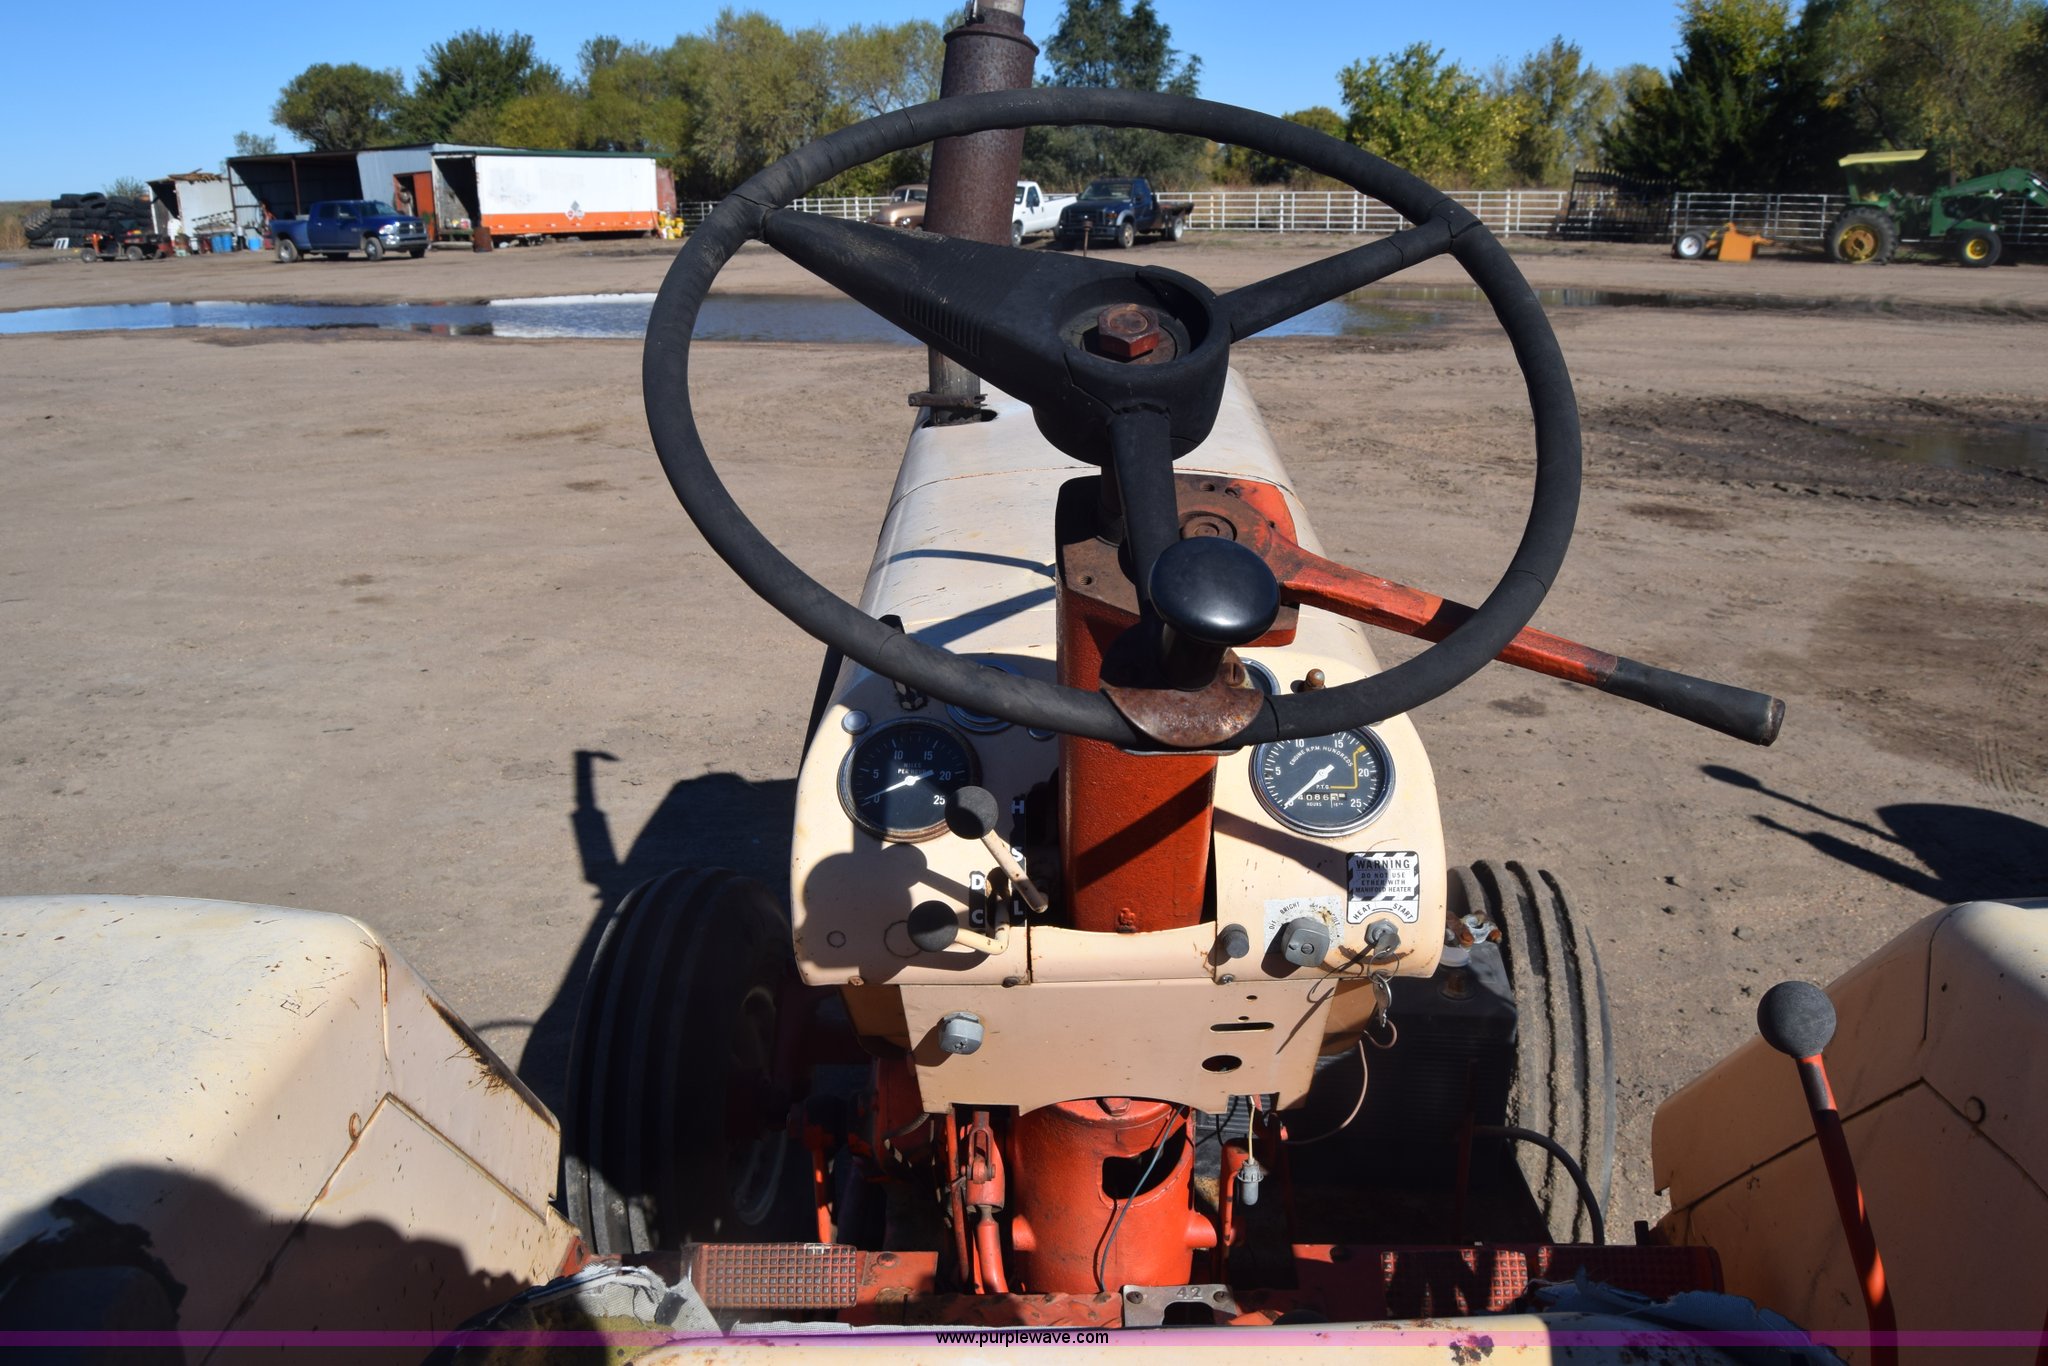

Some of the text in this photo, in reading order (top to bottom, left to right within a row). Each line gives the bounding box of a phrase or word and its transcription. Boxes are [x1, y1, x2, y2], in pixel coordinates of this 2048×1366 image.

[1295, 739, 1305, 748] 10
[1334, 739, 1344, 748] 15
[894, 751, 904, 760] 10
[924, 751, 933, 760] 15
[1289, 750, 1306, 766] ENGINE
[1322, 746, 1354, 767] HUNDREDS
[873, 769, 879, 779] 5
[940, 771, 951, 781] 20
[1275, 767, 1281, 776] 5
[1358, 768, 1370, 777] 20
[933, 794, 946, 805] 25
[1350, 798, 1362, 808] 25
[1011, 800, 1025, 814] H
[1011, 846, 1024, 862] S
[1356, 859, 1410, 869] WARNING
[971, 874, 985, 890] D
[1013, 900, 1024, 915] L
[1352, 904, 1371, 920] HEAT
[1392, 903, 1414, 920] START
[972, 909, 984, 924] C
